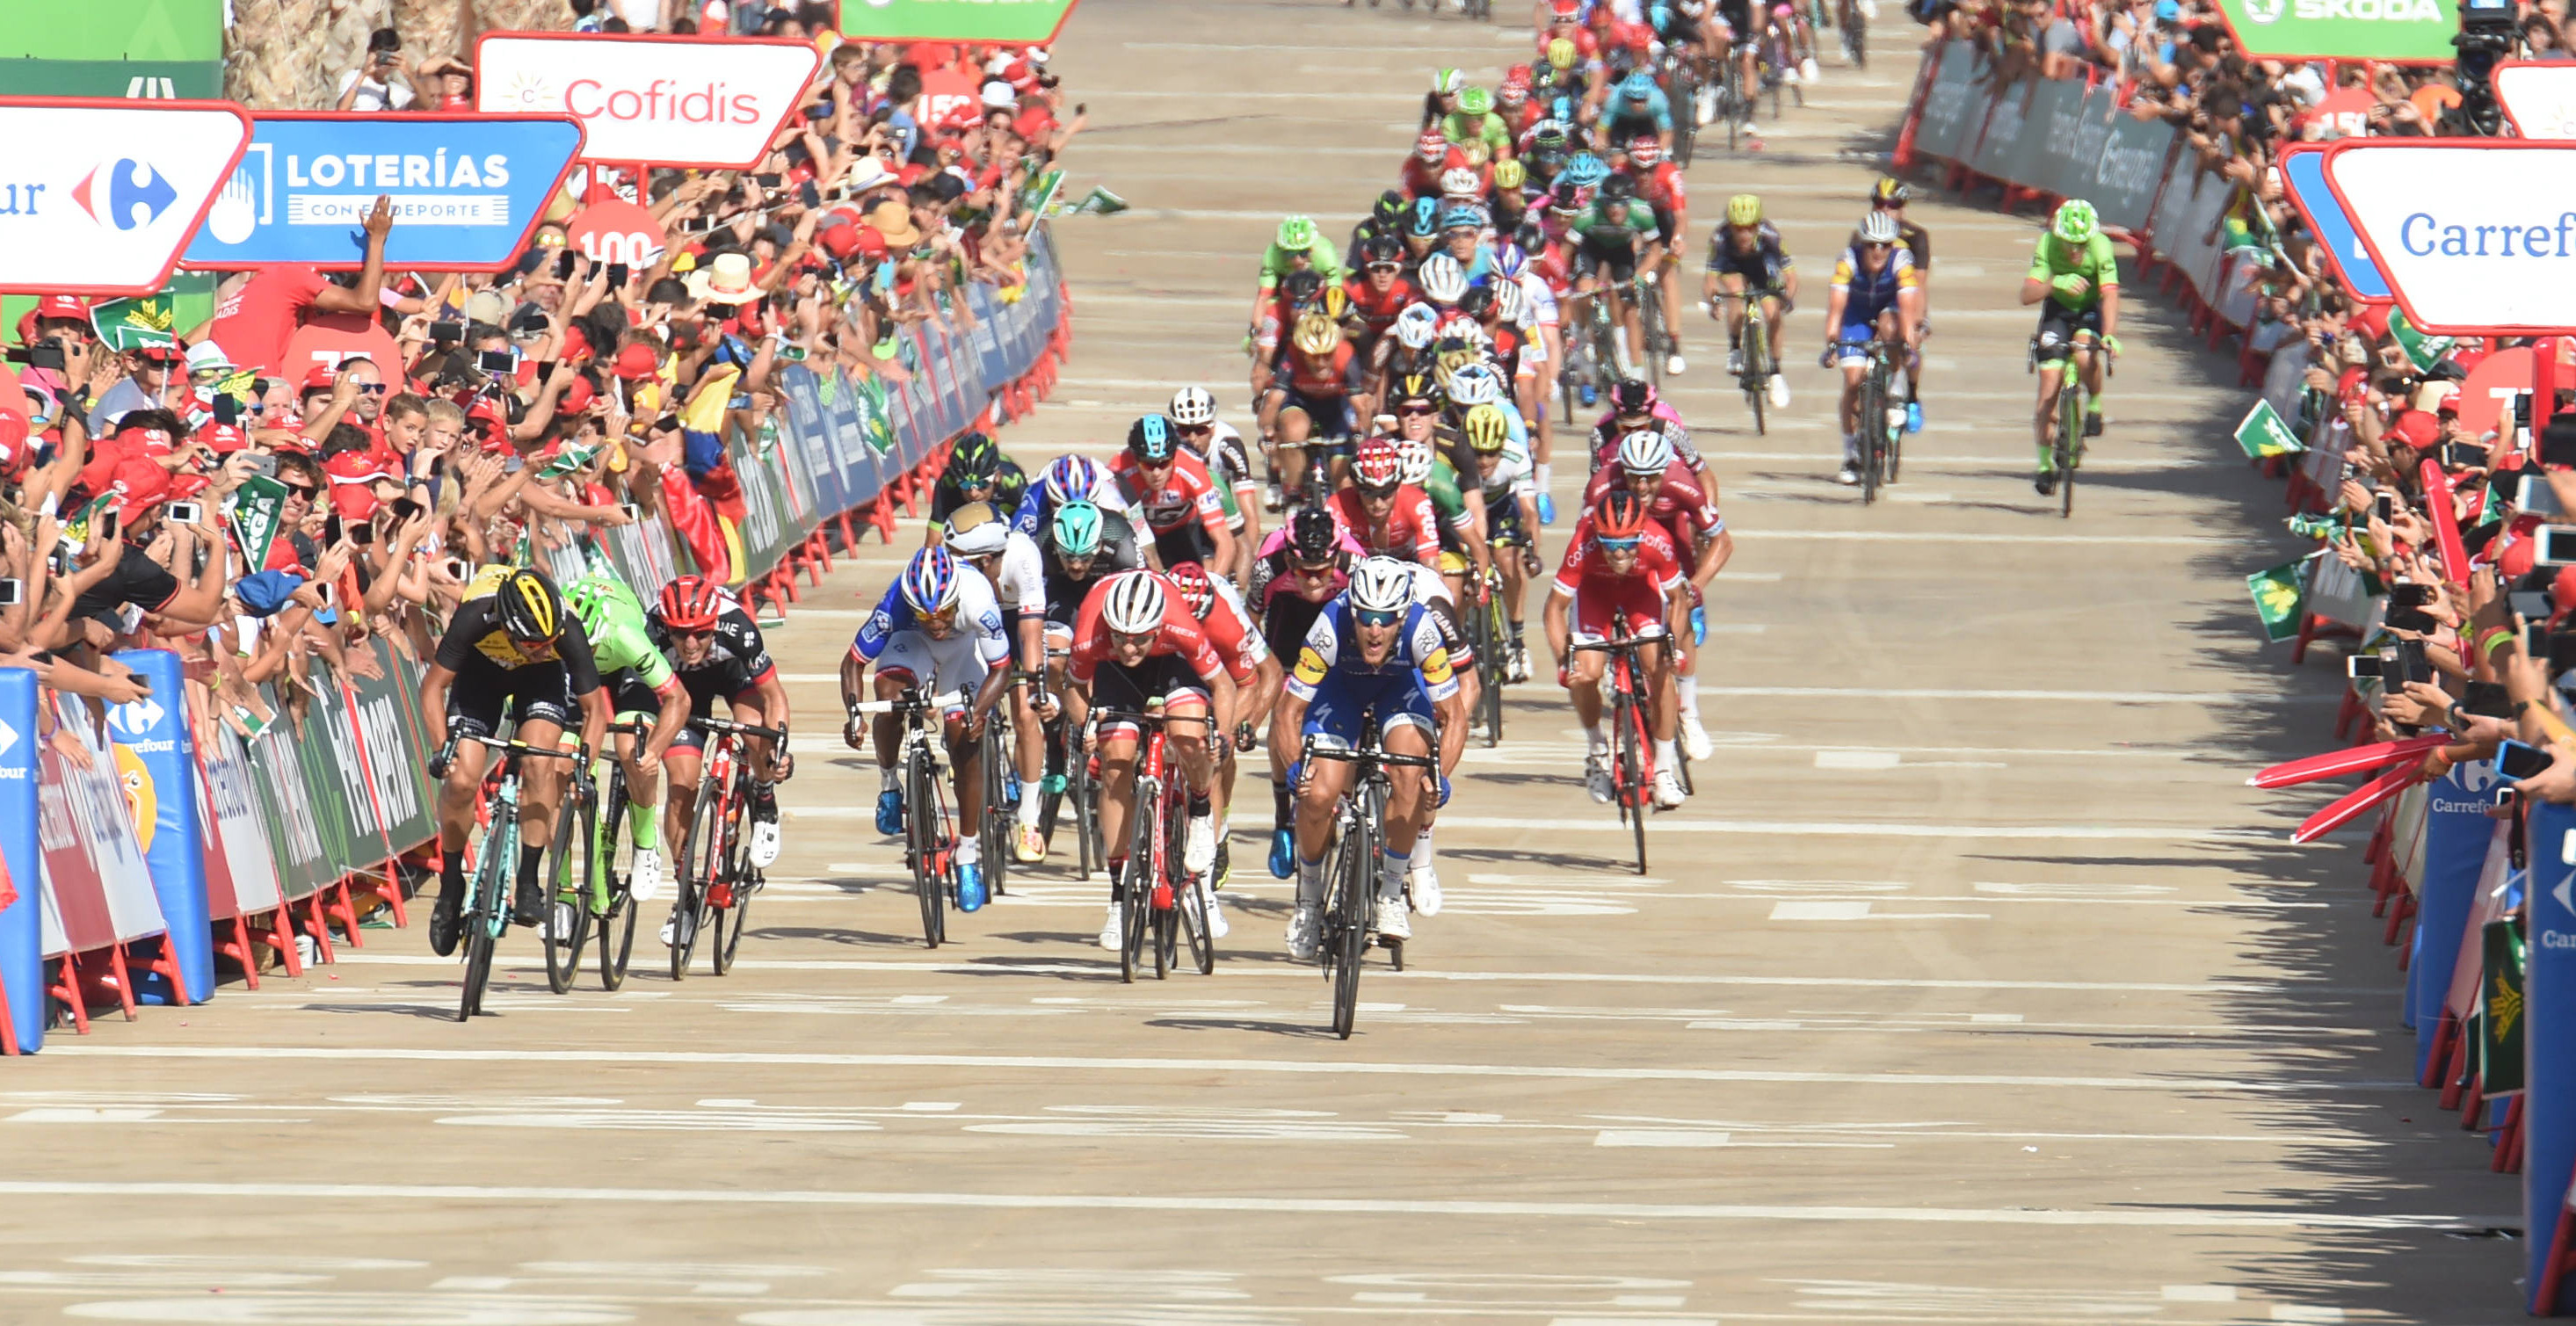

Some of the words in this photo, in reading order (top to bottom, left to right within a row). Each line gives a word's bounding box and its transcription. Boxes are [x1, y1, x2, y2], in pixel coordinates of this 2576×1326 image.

[564, 79, 760, 125] Cofidis
[287, 147, 510, 187] LOTERÍAS
[311, 204, 352, 216] CON
[580, 232, 653, 271] 100
[2400, 212, 2576, 257] Carref
